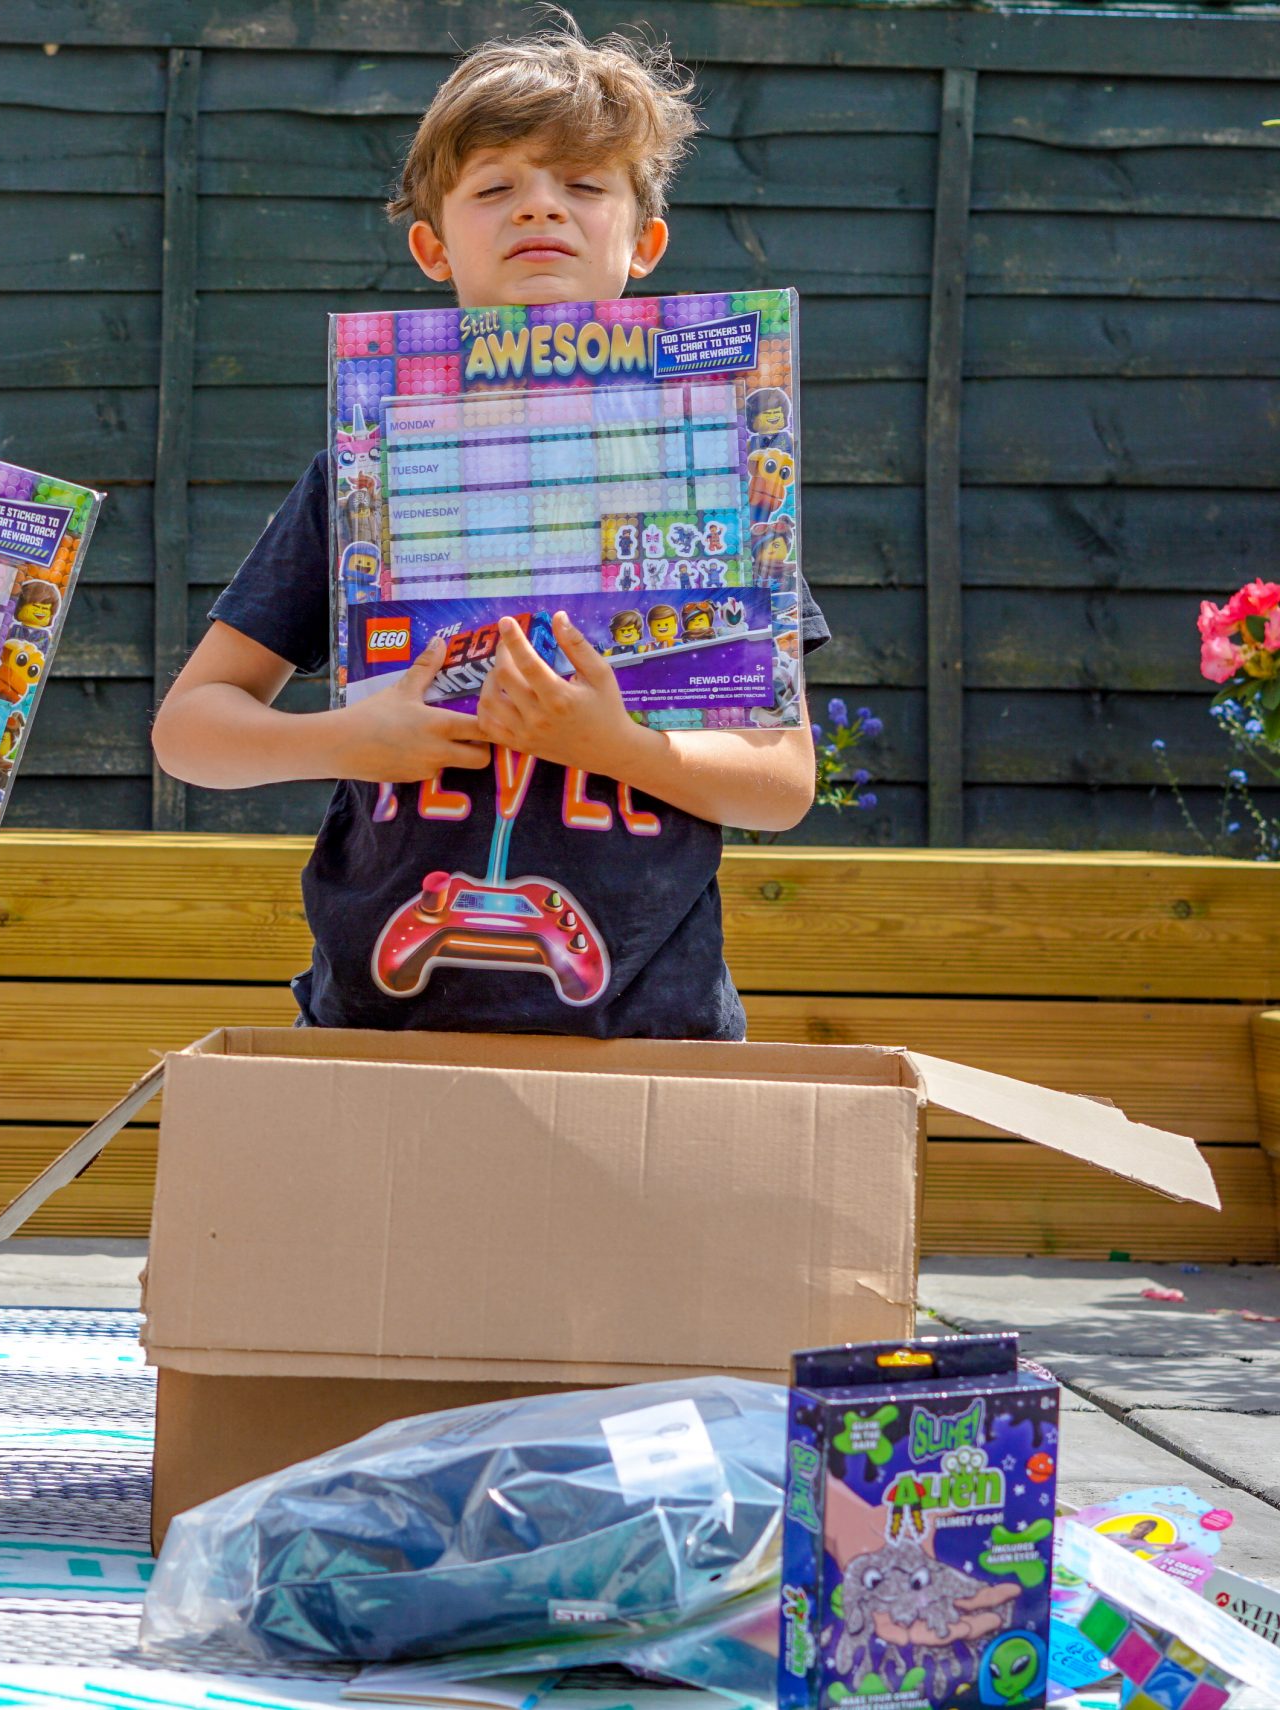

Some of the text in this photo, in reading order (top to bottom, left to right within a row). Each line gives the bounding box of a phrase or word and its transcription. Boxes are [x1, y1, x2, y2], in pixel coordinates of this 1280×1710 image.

[460, 310, 500, 341] Still
[661, 324, 751, 344] ADD THE STICKERS TO
[663, 334, 752, 355] THE CHART TO TRACK
[675, 346, 742, 363] YOUR REWARDS!
[390, 419, 436, 431] MONDAY
[391, 463, 439, 476] TUESDAY
[6, 507, 47, 524] STICKERS
[48, 516, 60, 528] TO
[393, 507, 460, 520] WEDNESDAY
[1, 528, 43, 547] REWARDS!
[16, 520, 28, 531] TO
[29, 524, 57, 539] TRACK
[394, 552, 451, 564] THURSDAY
[368, 629, 409, 650] LEGO
[434, 621, 463, 639] THE
[689, 674, 765, 685] REWARD CHART
[913, 1403, 981, 1459] SLIME!
